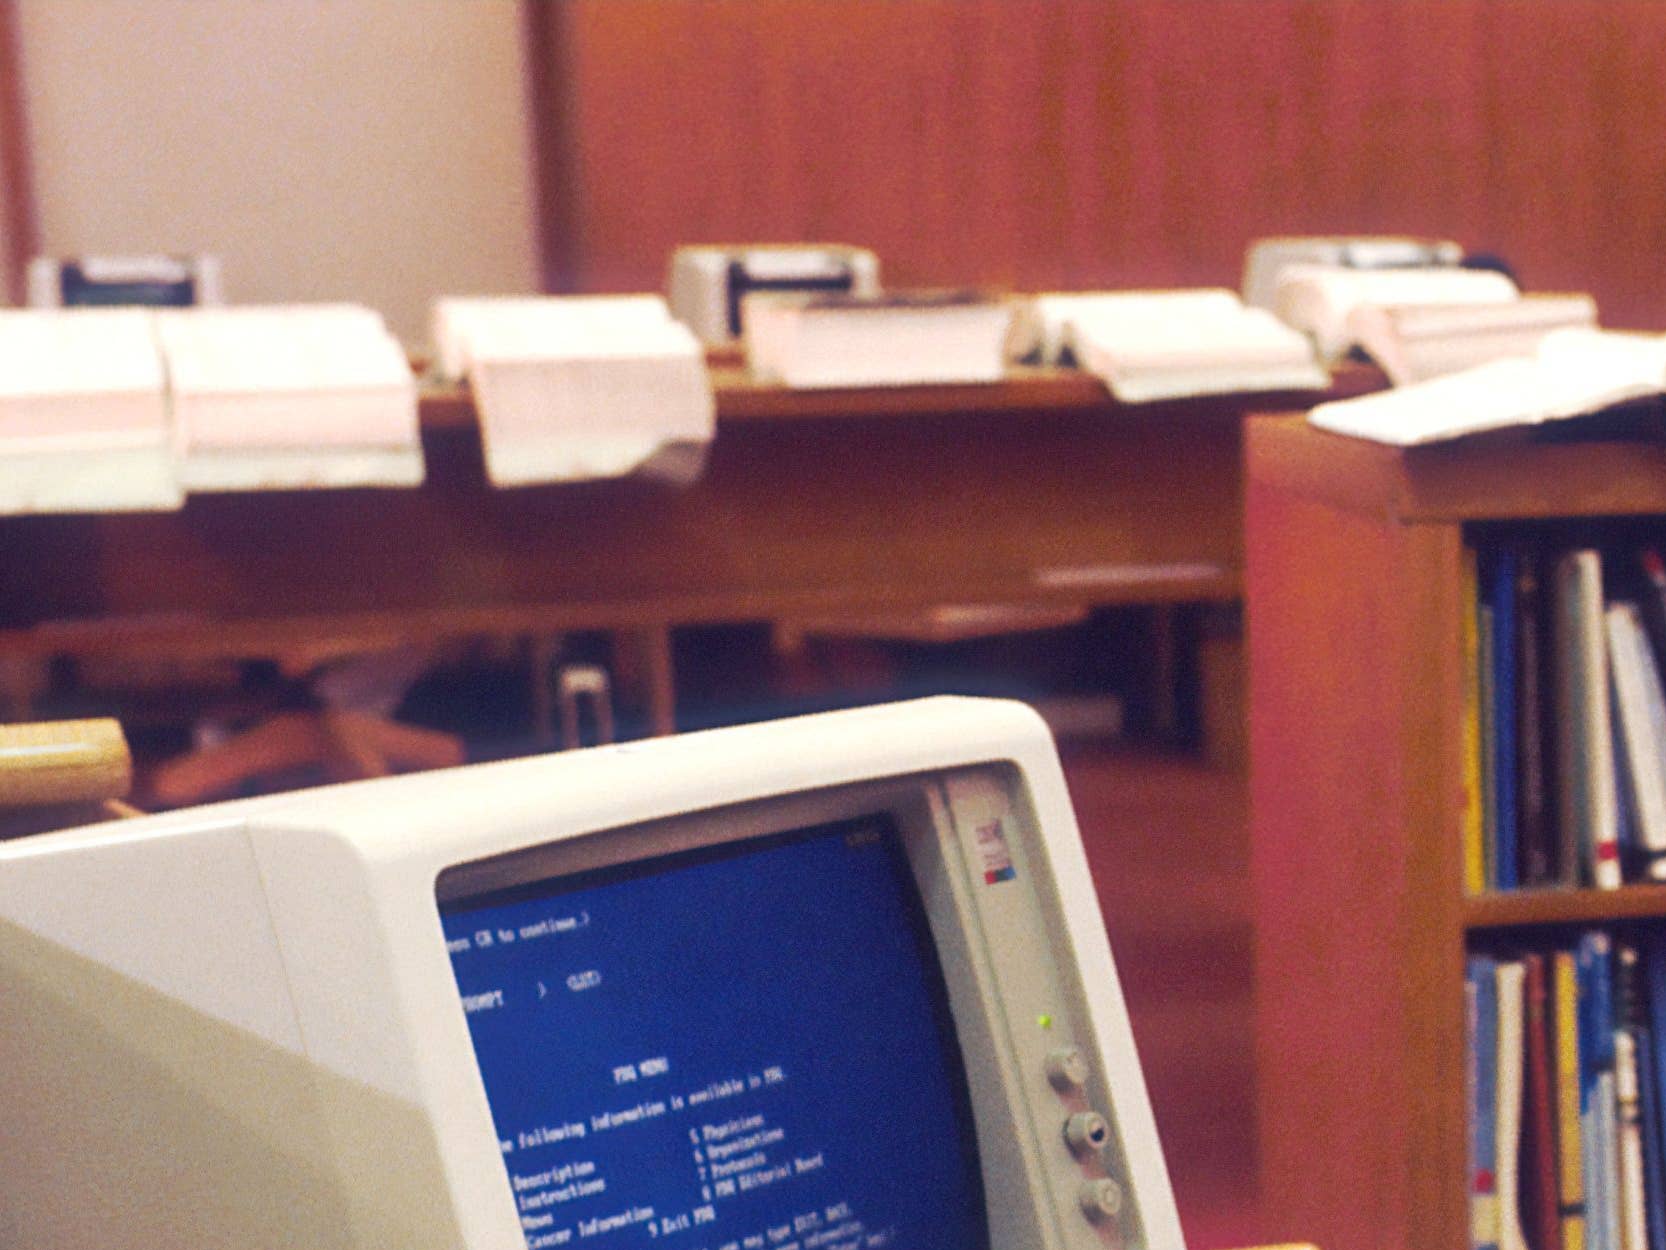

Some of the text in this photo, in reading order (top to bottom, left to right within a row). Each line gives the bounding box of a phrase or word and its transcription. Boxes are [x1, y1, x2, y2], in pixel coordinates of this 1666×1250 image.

[518, 1122, 586, 1149] following
[591, 1101, 667, 1131] information
[671, 1096, 684, 1111] is
[689, 1079, 744, 1105] available
[702, 1115, 764, 1141] Physicians
[706, 1128, 784, 1159] Organizations
[514, 1161, 595, 1191] Description
[519, 1178, 606, 1211] Instructions
[526, 1206, 655, 1250] Cancer Information
[662, 1214, 690, 1235] Exit
